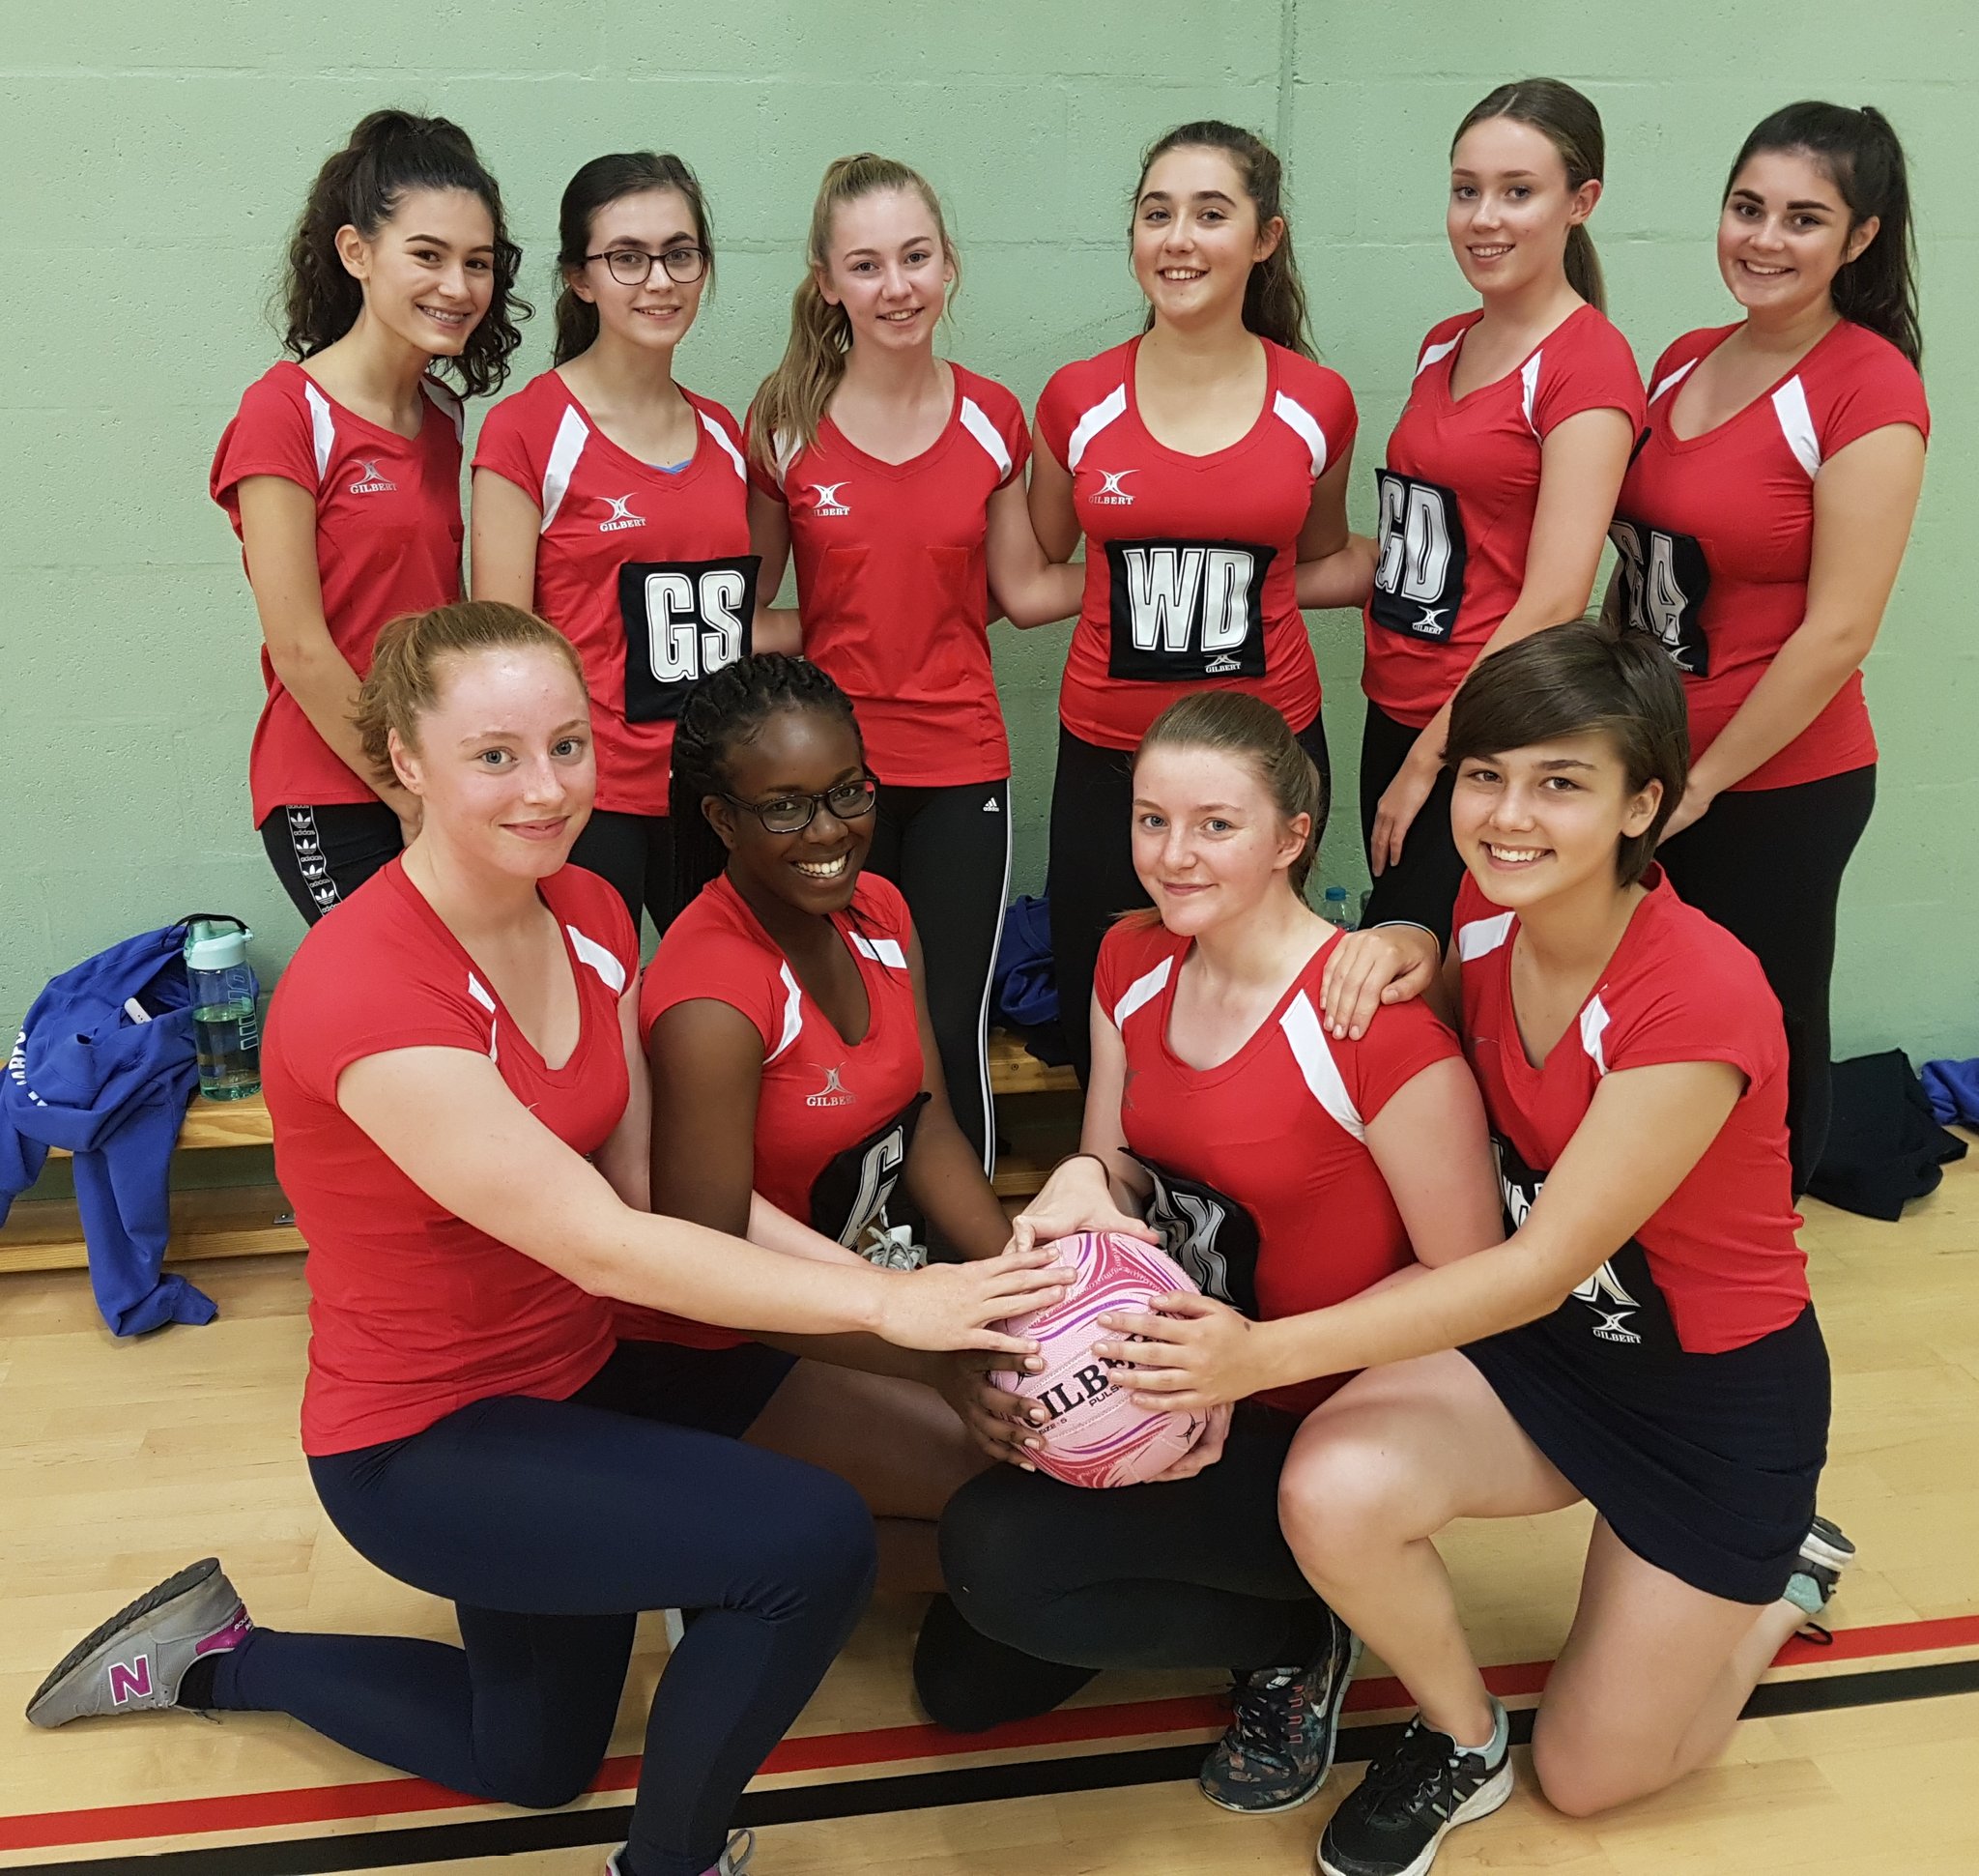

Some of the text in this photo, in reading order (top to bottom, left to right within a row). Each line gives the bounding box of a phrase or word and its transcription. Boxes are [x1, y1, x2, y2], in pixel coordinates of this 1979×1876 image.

[350, 483, 397, 494] GILBERT
[1088, 495, 1134, 505] GILBERT
[814, 508, 850, 517] ILBERT
[599, 519, 646, 532] GILBERT
[1375, 476, 1451, 604] GD
[1122, 548, 1254, 652] WD
[645, 570, 745, 682] GS
[1412, 623, 1443, 635] GILBERT
[1206, 663, 1241, 673] GILBERT
[301, 854, 324, 863] adidas
[309, 879, 331, 888] adidas
[1592, 1329, 1642, 1344] GILBERT
[1089, 1383, 1123, 1407] PULS
